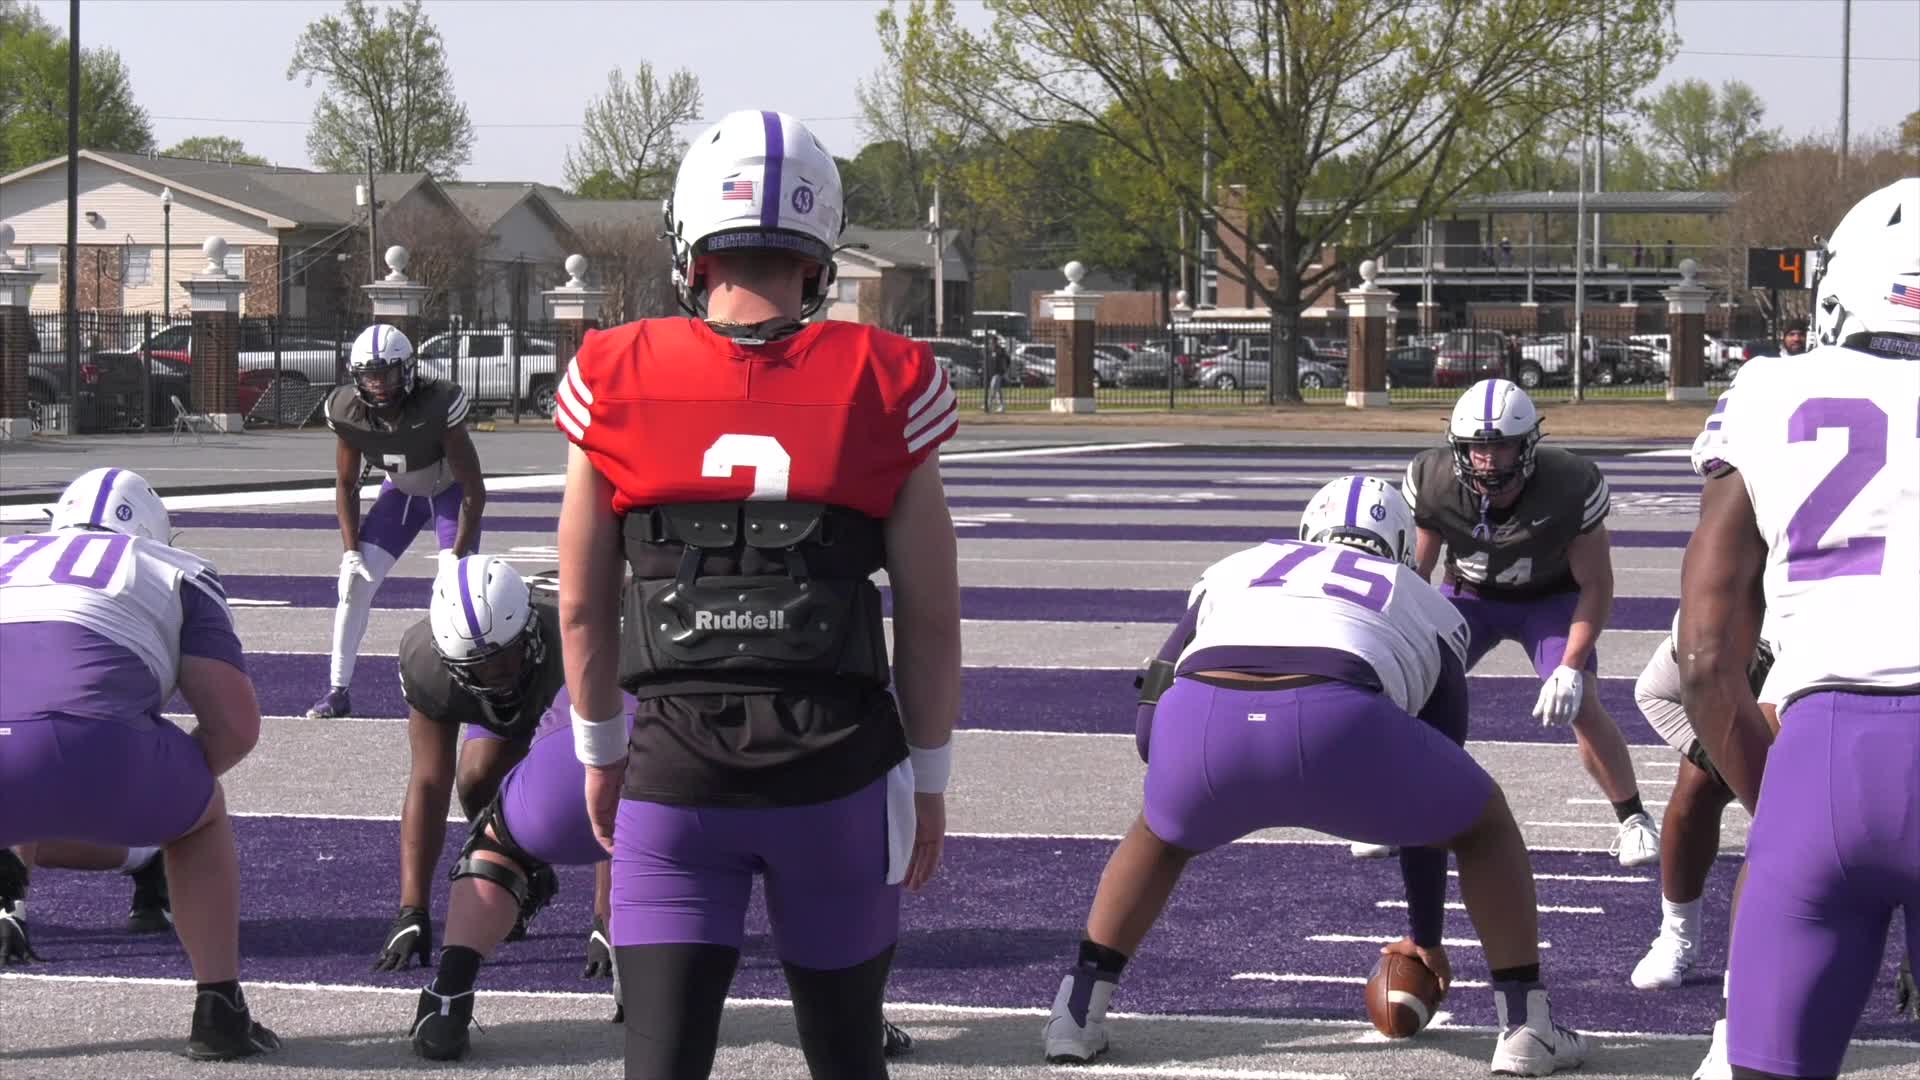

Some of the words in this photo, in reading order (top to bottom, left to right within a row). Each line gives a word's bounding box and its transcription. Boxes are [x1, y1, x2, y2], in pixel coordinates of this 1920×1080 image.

[1778, 254, 1801, 284] 4
[1786, 397, 1920, 582] 2
[0, 534, 131, 589] 70
[1248, 538, 1400, 613] 75
[695, 610, 785, 630] Riddell
